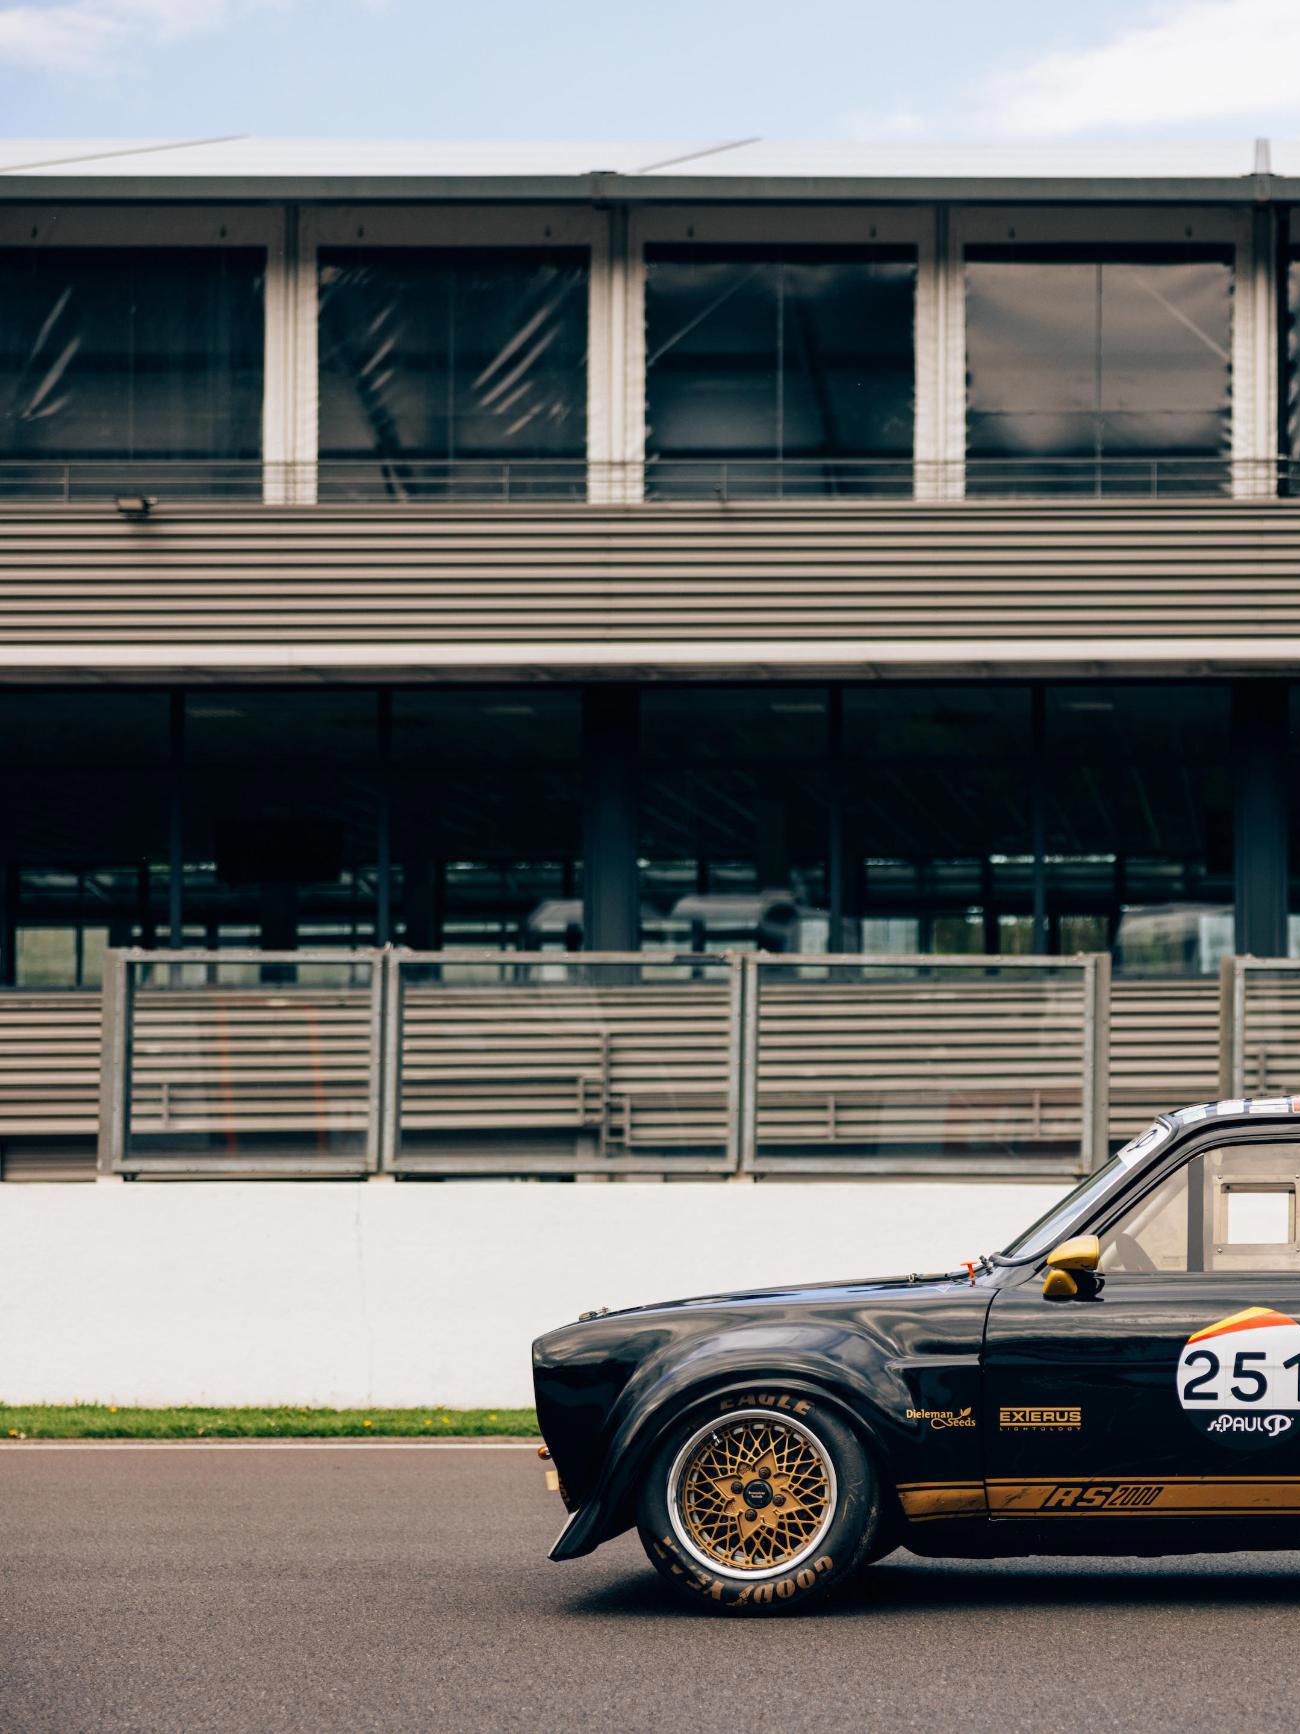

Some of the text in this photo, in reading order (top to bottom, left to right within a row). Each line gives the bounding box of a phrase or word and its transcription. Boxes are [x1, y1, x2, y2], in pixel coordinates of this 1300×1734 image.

[719, 1393, 816, 1416] EAGLE
[905, 1409, 954, 1419] Dieleman
[999, 1408, 1082, 1422] EXTERUS
[946, 1416, 976, 1427] Seeds
[1107, 1485, 1165, 1507] 2000
